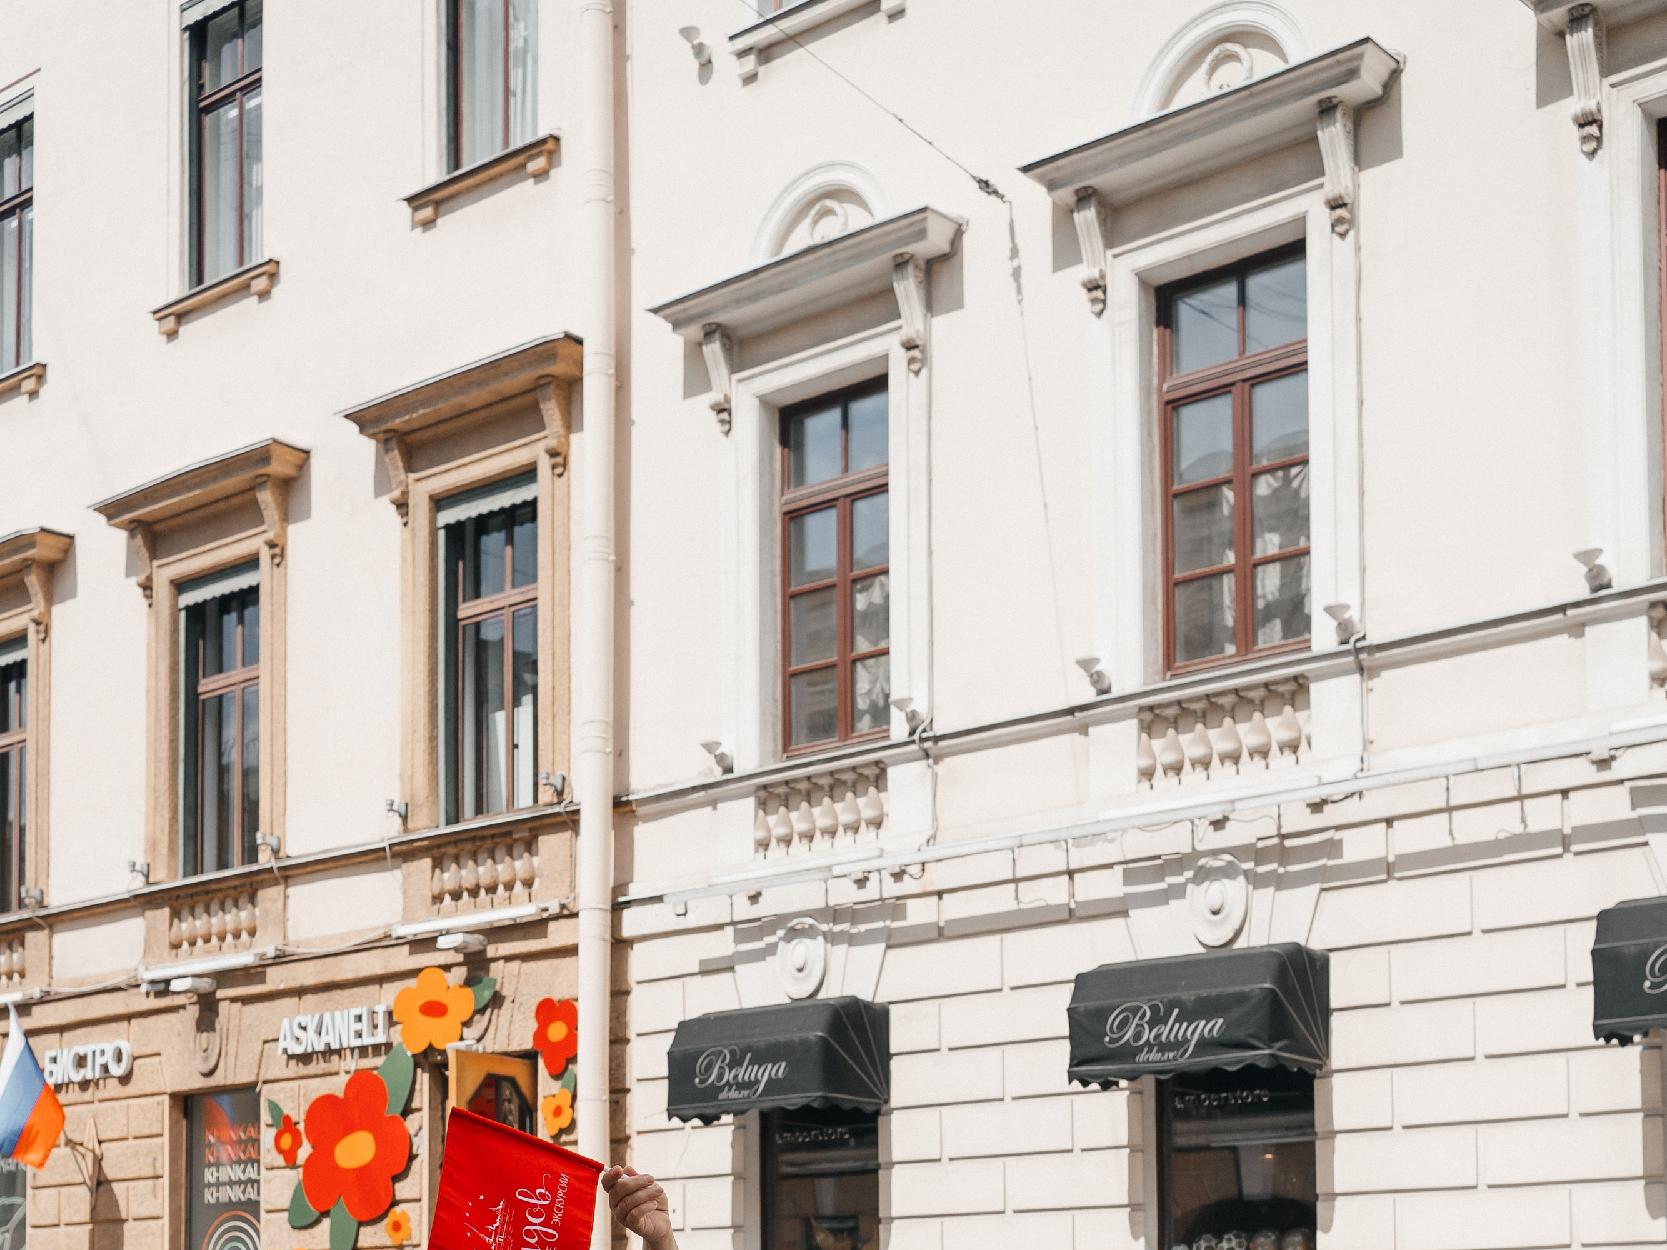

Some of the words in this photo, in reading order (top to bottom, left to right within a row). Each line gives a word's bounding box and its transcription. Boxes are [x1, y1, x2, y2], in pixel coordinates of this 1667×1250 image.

[278, 1003, 388, 1056] ASKANELI
[1104, 1001, 1224, 1062] Beluga
[43, 1040, 132, 1084] БИСТРО
[694, 1046, 787, 1099] Beluga
[550, 1173, 569, 1226] ЭКСКУРСИИ
